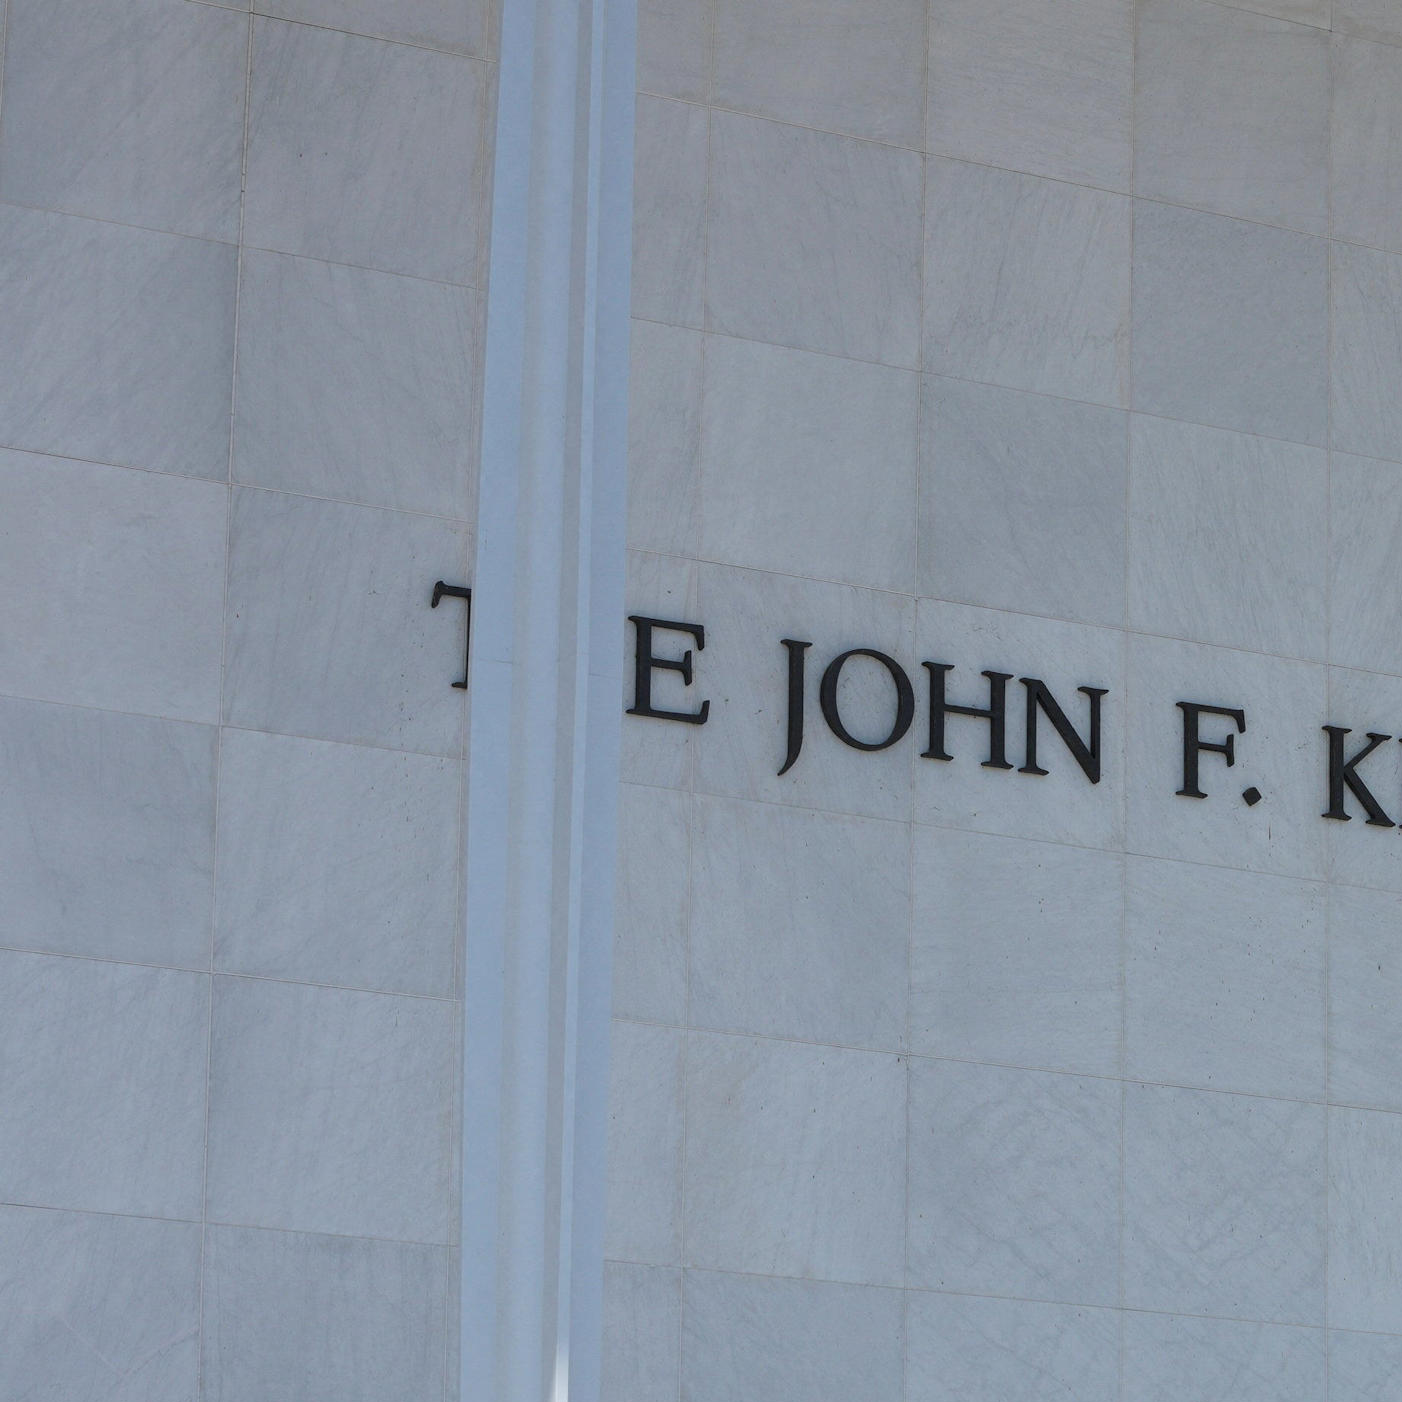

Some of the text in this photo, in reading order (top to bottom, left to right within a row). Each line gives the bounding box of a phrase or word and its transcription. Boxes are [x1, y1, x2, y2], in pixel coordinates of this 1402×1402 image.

[430, 580, 711, 726] TE
[776, 638, 1110, 785] JOHN
[1175, 700, 1263, 807] F.
